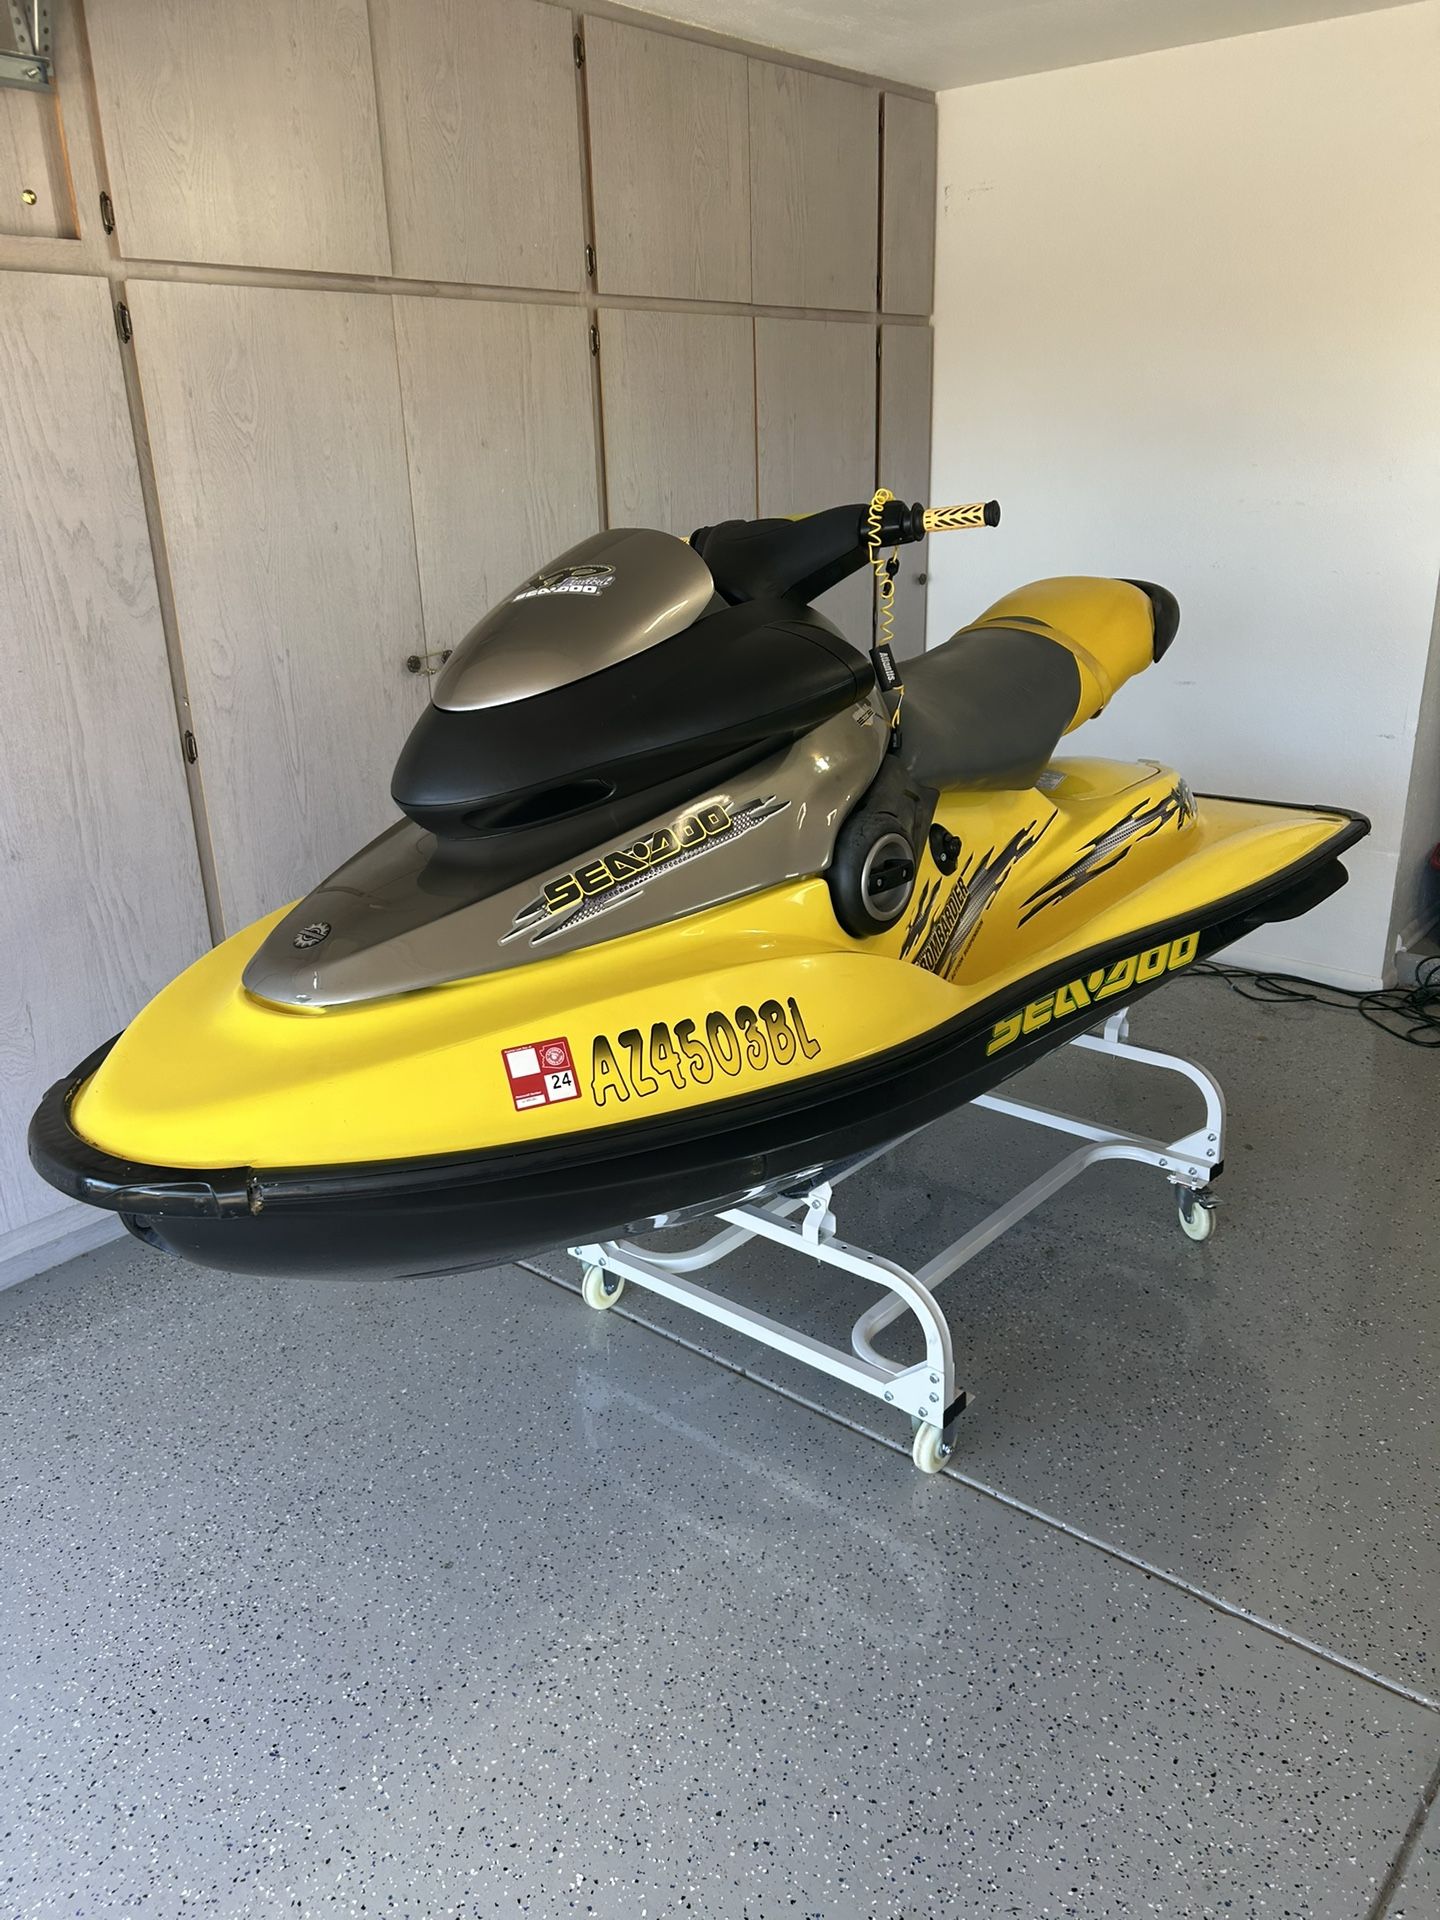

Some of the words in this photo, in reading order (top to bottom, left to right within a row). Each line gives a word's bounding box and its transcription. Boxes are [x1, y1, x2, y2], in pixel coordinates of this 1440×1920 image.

[879, 651, 896, 683] Atlantis
[590, 996, 822, 1107] AZ4503BL
[551, 1072, 572, 1090] 24
